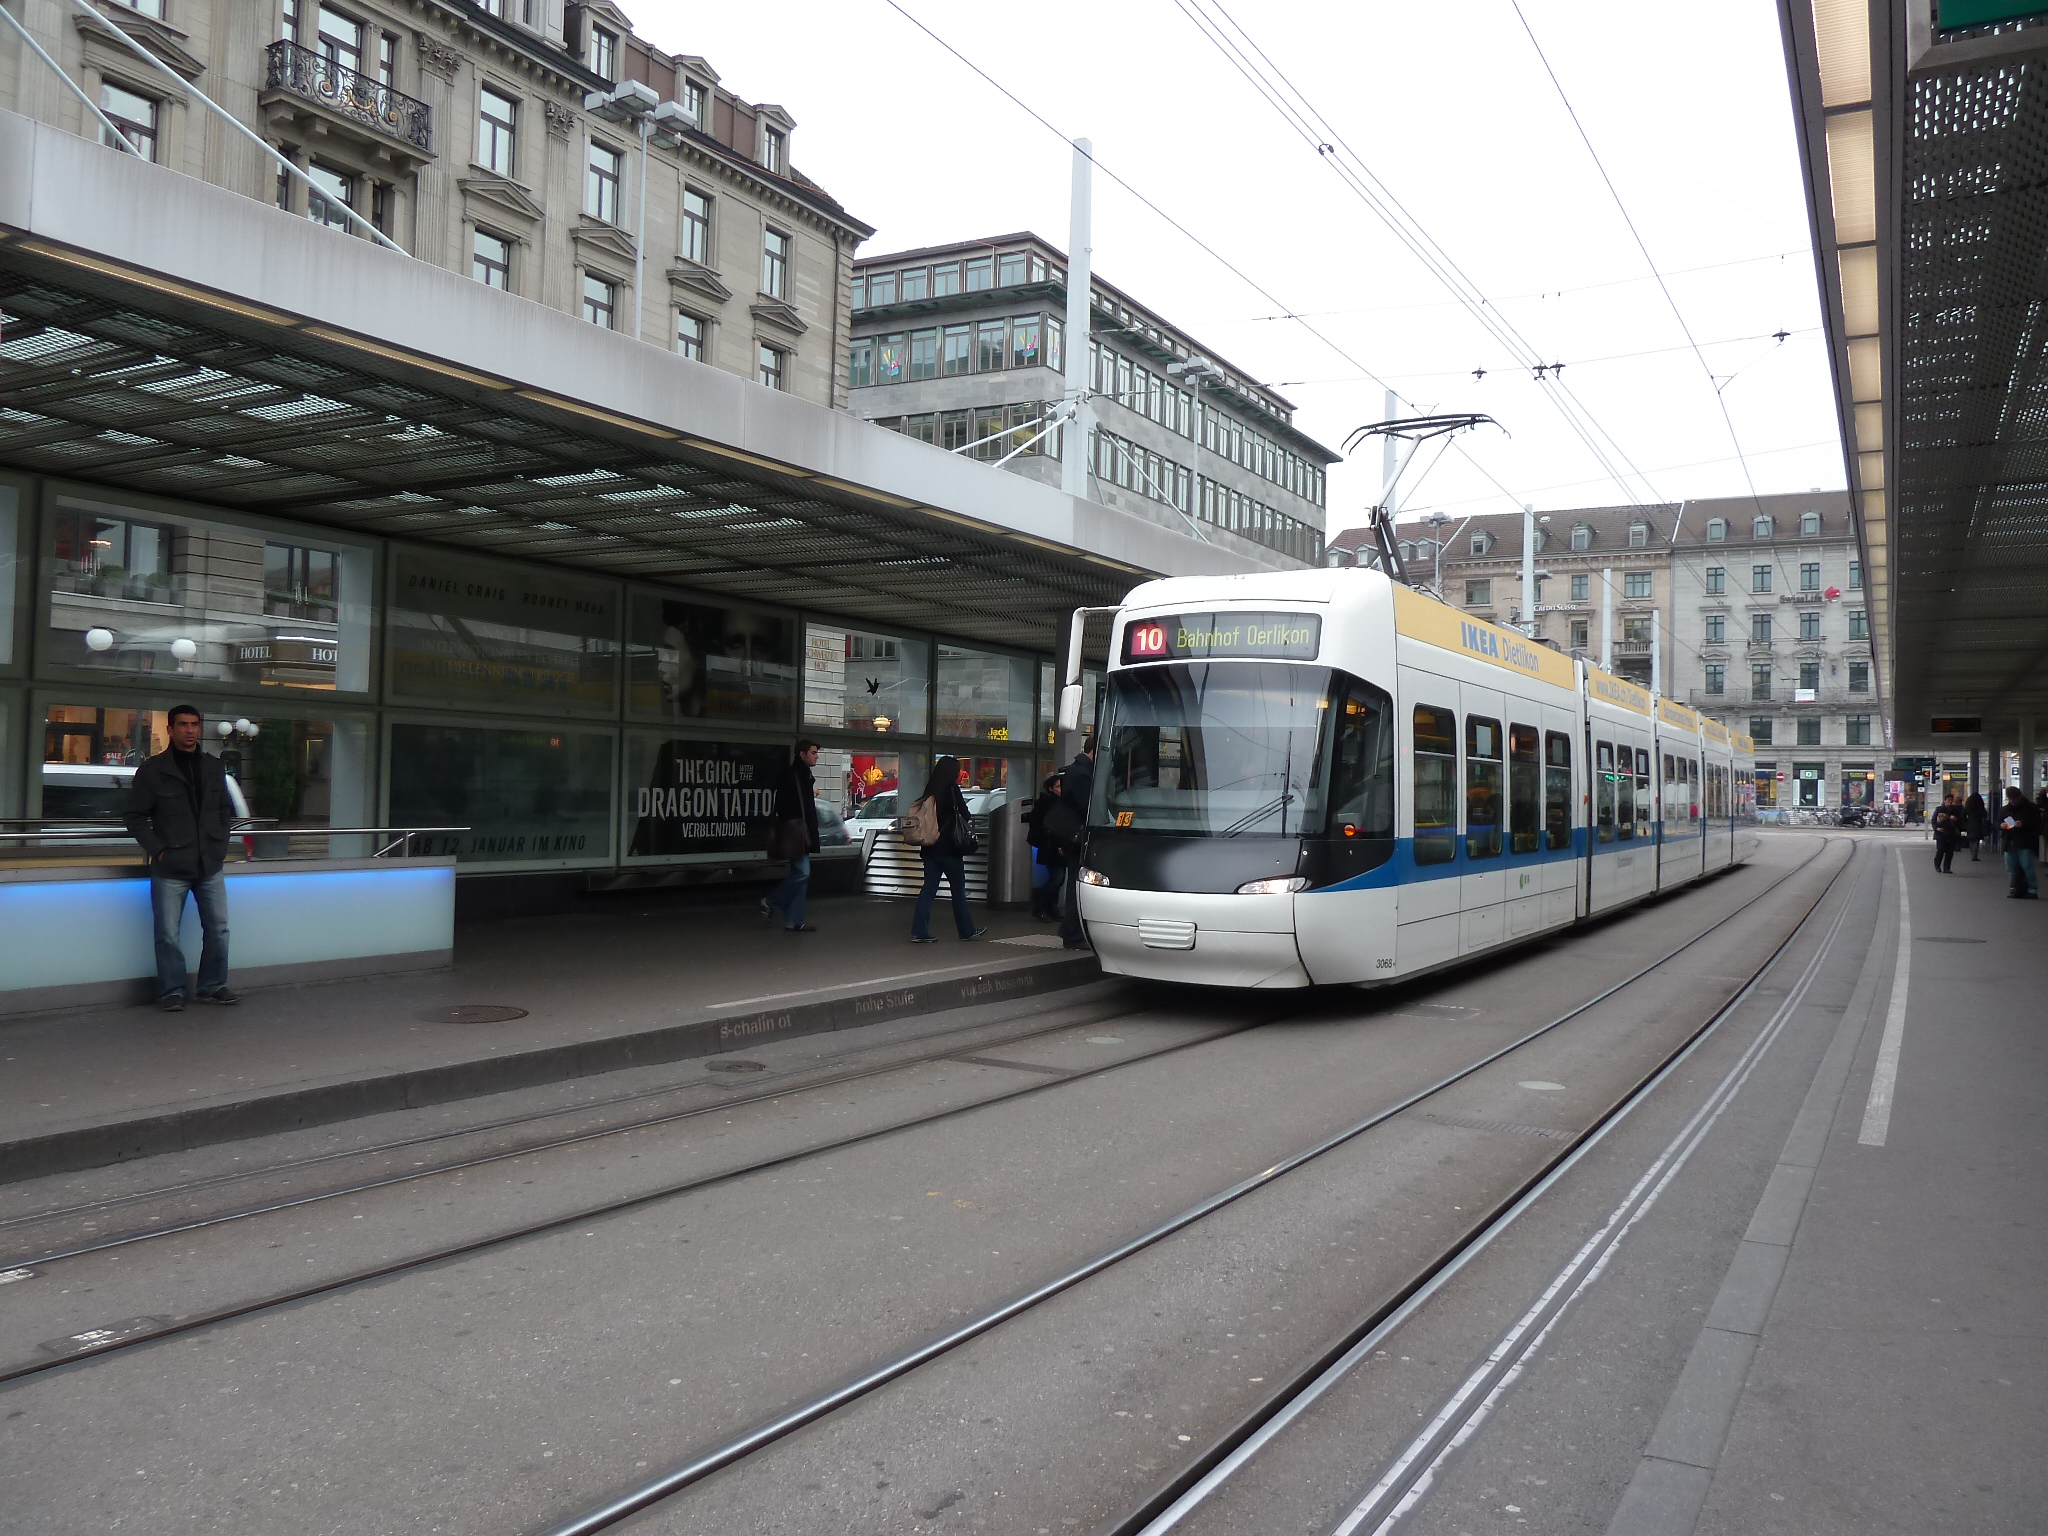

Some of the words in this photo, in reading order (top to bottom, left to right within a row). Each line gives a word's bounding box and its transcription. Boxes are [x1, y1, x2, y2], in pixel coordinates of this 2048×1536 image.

[409, 574, 459, 593] DANIEL
[467, 583, 506, 601] CRAIG
[523, 593, 569, 610] ROONEY
[575, 601, 604, 616] MARA
[1137, 628, 1164, 651] 10
[1176, 626, 1240, 648] Bahnhof
[1247, 624, 1310, 645] Oerlikon
[1461, 621, 1499, 658] IKEA
[1502, 637, 1540, 672] Dietlikon
[240, 646, 272, 659] HOTEL
[987, 727, 1008, 736] Jack
[739, 764, 754, 772] WITH
[739, 772, 754, 781] THE
[638, 787, 719, 821] DRAGON
[720, 787, 779, 820] TATTO
[682, 821, 746, 838] VERBLENDUNG
[412, 838, 433, 855] AB
[442, 837, 464, 854] 12.
[470, 836, 525, 854] JANUAR
[532, 835, 549, 852] IM
[554, 834, 586, 851] KINO
[1375, 958, 1393, 969] 3068
[855, 997, 884, 1014] hohe
[886, 990, 915, 1008] Stufe
[778, 1013, 792, 1029] ot
